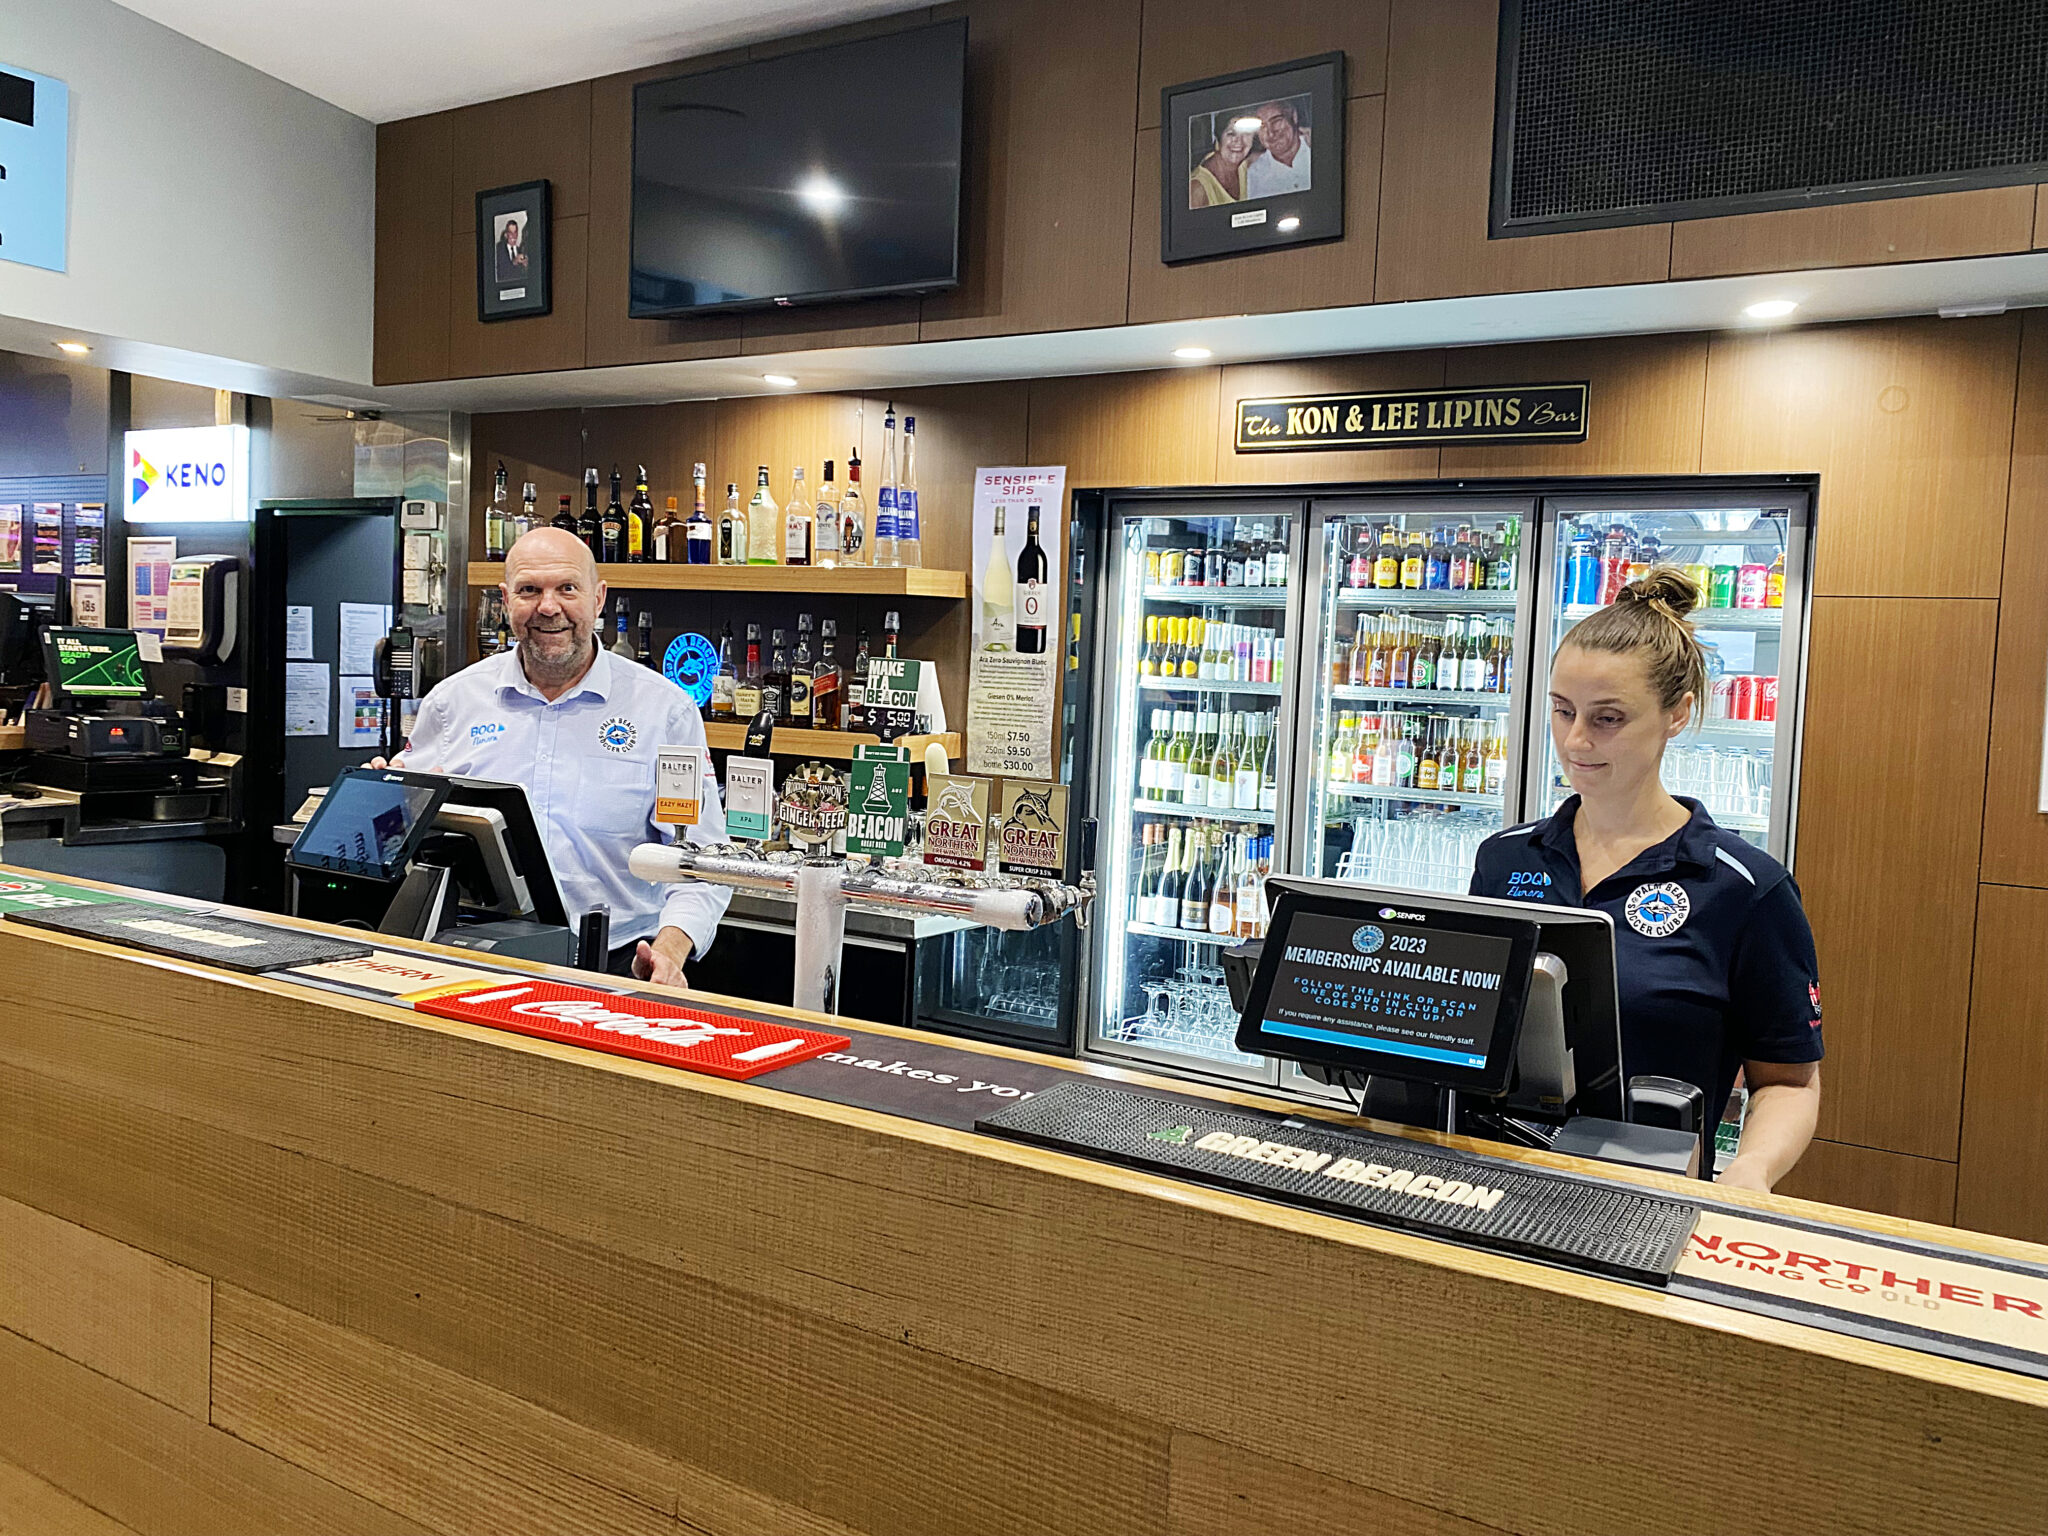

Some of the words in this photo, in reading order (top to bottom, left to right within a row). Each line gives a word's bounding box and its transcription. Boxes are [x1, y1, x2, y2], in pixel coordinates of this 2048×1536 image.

[1244, 414, 1281, 436] The
[1286, 405, 1339, 435] KON
[1345, 405, 1365, 432] &
[1372, 401, 1419, 431] LEE
[1426, 398, 1521, 429] LIPINS
[1527, 402, 1580, 425] Bar
[166, 463, 225, 487] KENO
[1002, 486, 1034, 495] SIPS
[82, 600, 95, 612] 18s
[668, 636, 688, 660] PALM
[690, 635, 717, 669] BEACH
[1002, 657, 1030, 665] Sauvignon
[869, 660, 905, 677] MAKE
[868, 675, 879, 689] IT
[880, 675, 889, 691] A
[866, 690, 917, 707] BEACON
[471, 723, 496, 737] BOQ
[600, 718, 616, 731] PALM
[618, 718, 637, 735] BEACH
[598, 735, 620, 753] SOCCER
[621, 739, 637, 753] CLUB
[1007, 731, 1030, 742] $7.50
[1007, 746, 1031, 756] $9.50
[662, 762, 693, 771] BALTER
[1003, 760, 1034, 771] $30.00
[731, 774, 763, 785] BALTER
[779, 806, 815, 828] GINGER
[847, 813, 904, 842] BEACON
[928, 819, 983, 841] GREAT
[927, 837, 979, 851] NORTHERN
[1003, 828, 1060, 849] GREAT
[933, 856, 958, 866] ORIGINAL
[1003, 845, 1057, 860] NORTHERN
[1508, 872, 1543, 885] BOQ
[1635, 883, 1662, 898] PALM
[1665, 883, 1687, 911] BEACH
[1396, 911, 1426, 921] SENPOS
[1627, 903, 1653, 935] SOCCER
[1656, 917, 1680, 935] CLUB
[1389, 934, 1428, 954] 2023
[1284, 945, 1382, 974] MEMBERSHIPS
[1382, 959, 1460, 985] AVAILABLE
[1461, 970, 1501, 991] NOW!
[1293, 977, 1345, 991] FOLLOW
[1351, 985, 1374, 996] THE
[1380, 990, 1411, 1001] LINK
[1417, 996, 1435, 1005] OR
[1441, 1000, 1477, 1011] SCAN
[1301, 986, 1326, 997] ONE
[1332, 991, 1348, 1000] OF
[1354, 994, 1380, 1005] OUR
[1386, 1000, 1399, 1008] IN
[1406, 1002, 1439, 1014] CLUB
[1446, 1008, 1464, 1017] QR
[1315, 996, 1357, 1009] CODES
[1363, 1004, 1379, 1013] TO
[1385, 1007, 1416, 1019] SIGN
[1423, 1013, 1445, 1023] UP!
[1284, 1009, 1297, 1017] you
[1297, 1011, 1322, 1021] require
[1322, 1016, 1335, 1024] any
[1376, 1024, 1400, 1034] please
[1401, 1028, 1414, 1036] see
[1415, 1030, 1428, 1038] our
[1429, 1032, 1456, 1044] friendly
[816, 1051, 960, 1085] makes
[1194, 1131, 1333, 1173] GREEN
[1322, 1157, 1504, 1212] BEACON
[1880, 1290, 1941, 1311] QLD
